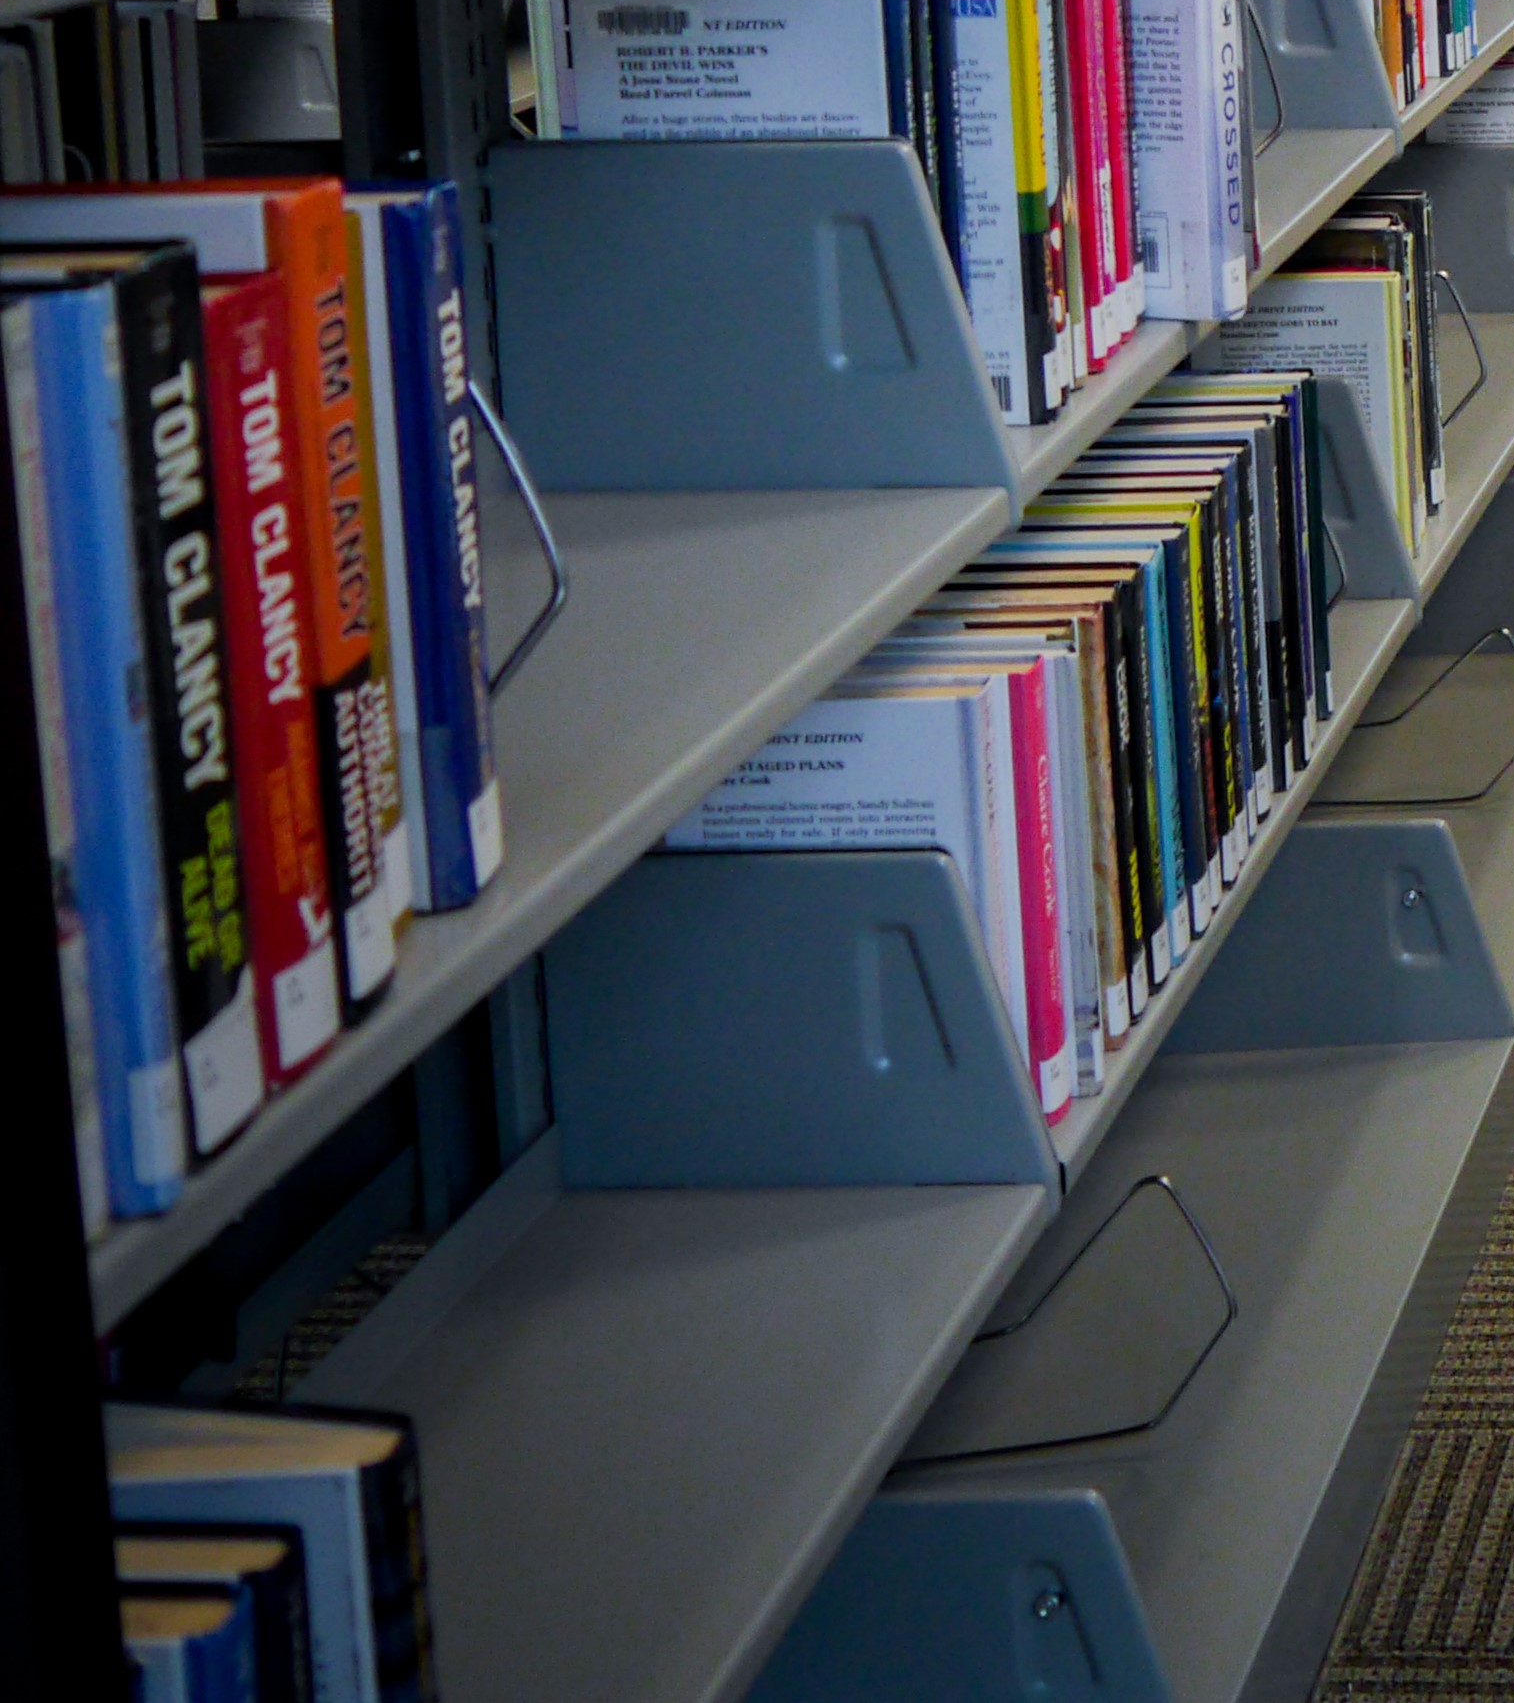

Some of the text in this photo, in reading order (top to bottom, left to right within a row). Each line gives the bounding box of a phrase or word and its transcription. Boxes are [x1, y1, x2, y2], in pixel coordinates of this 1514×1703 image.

[725, 19, 787, 31] EDITION
[617, 45, 768, 58] ROBERT PARKER'S
[620, 60, 735, 71] THE DEVIL WINS
[632, 74, 739, 86] Jesse Stone Novel
[620, 88, 751, 99] Reed Farrel Coleman
[1258, 305, 1325, 314] PRINT EDITION
[1322, 319, 1339, 327] BAT
[240, 368, 287, 497] TOM
[437, 287, 483, 612] TOM CLANCY
[315, 275, 373, 643] TOM CLANCY
[150, 357, 231, 793] TOM CLANCY
[250, 501, 304, 708] CLANCY
[739, 760, 845, 772] STAGED PLANS
[740, 777, 771, 785] Cook
[1037, 754, 1058, 919] Claire Cook
[205, 798, 239, 911] DEAD
[180, 851, 218, 972] ALIVE
